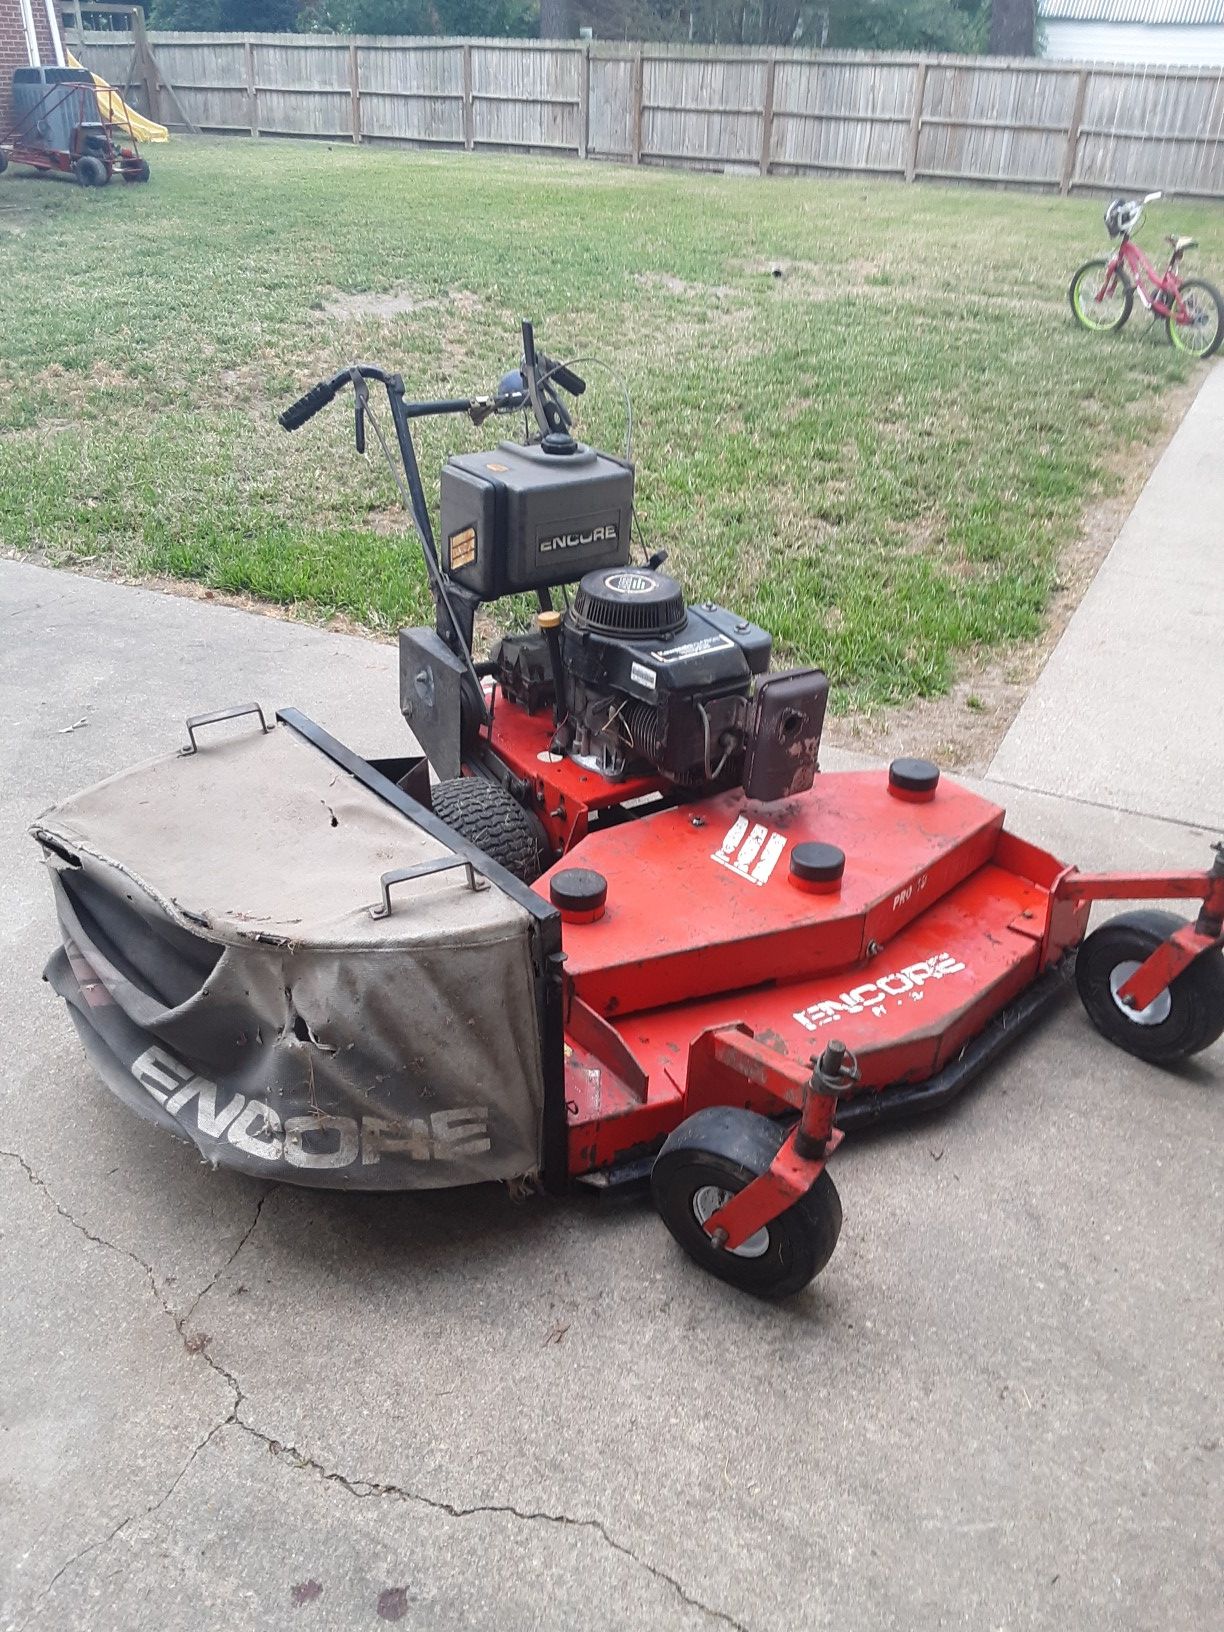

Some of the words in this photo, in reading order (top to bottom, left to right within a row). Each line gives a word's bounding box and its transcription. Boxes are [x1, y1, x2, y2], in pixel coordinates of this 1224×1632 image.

[540, 525, 617, 552] ENCORE
[793, 953, 966, 1031] ENCORE
[131, 1045, 492, 1169] ENCORE
